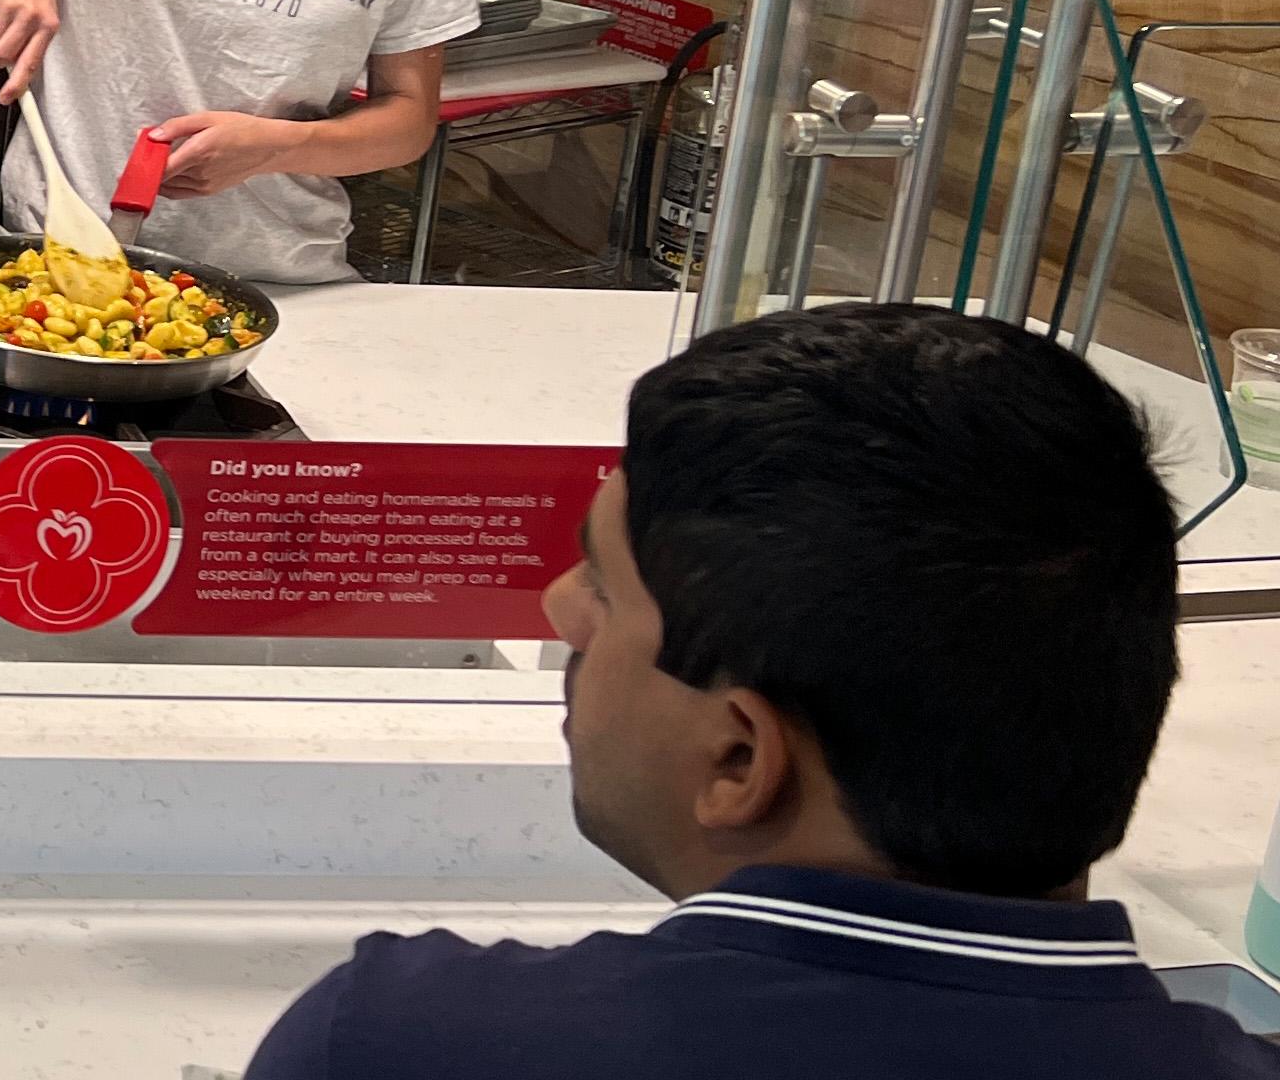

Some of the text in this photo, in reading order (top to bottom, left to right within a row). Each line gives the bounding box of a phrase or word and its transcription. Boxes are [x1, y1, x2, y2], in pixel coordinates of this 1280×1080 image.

[210, 460, 363, 478] Did you know?
[207, 488, 556, 508] Cooking and eating homemade meals is
[204, 508, 522, 529] often much cheaper than eating at a
[202, 530, 529, 547] restaurant or buying processed foods
[200, 547, 545, 567] from a quick mart. It can also save time.
[197, 568, 508, 587] especially when you meal prep on a
[196, 587, 439, 603] weekend for an entire week.
